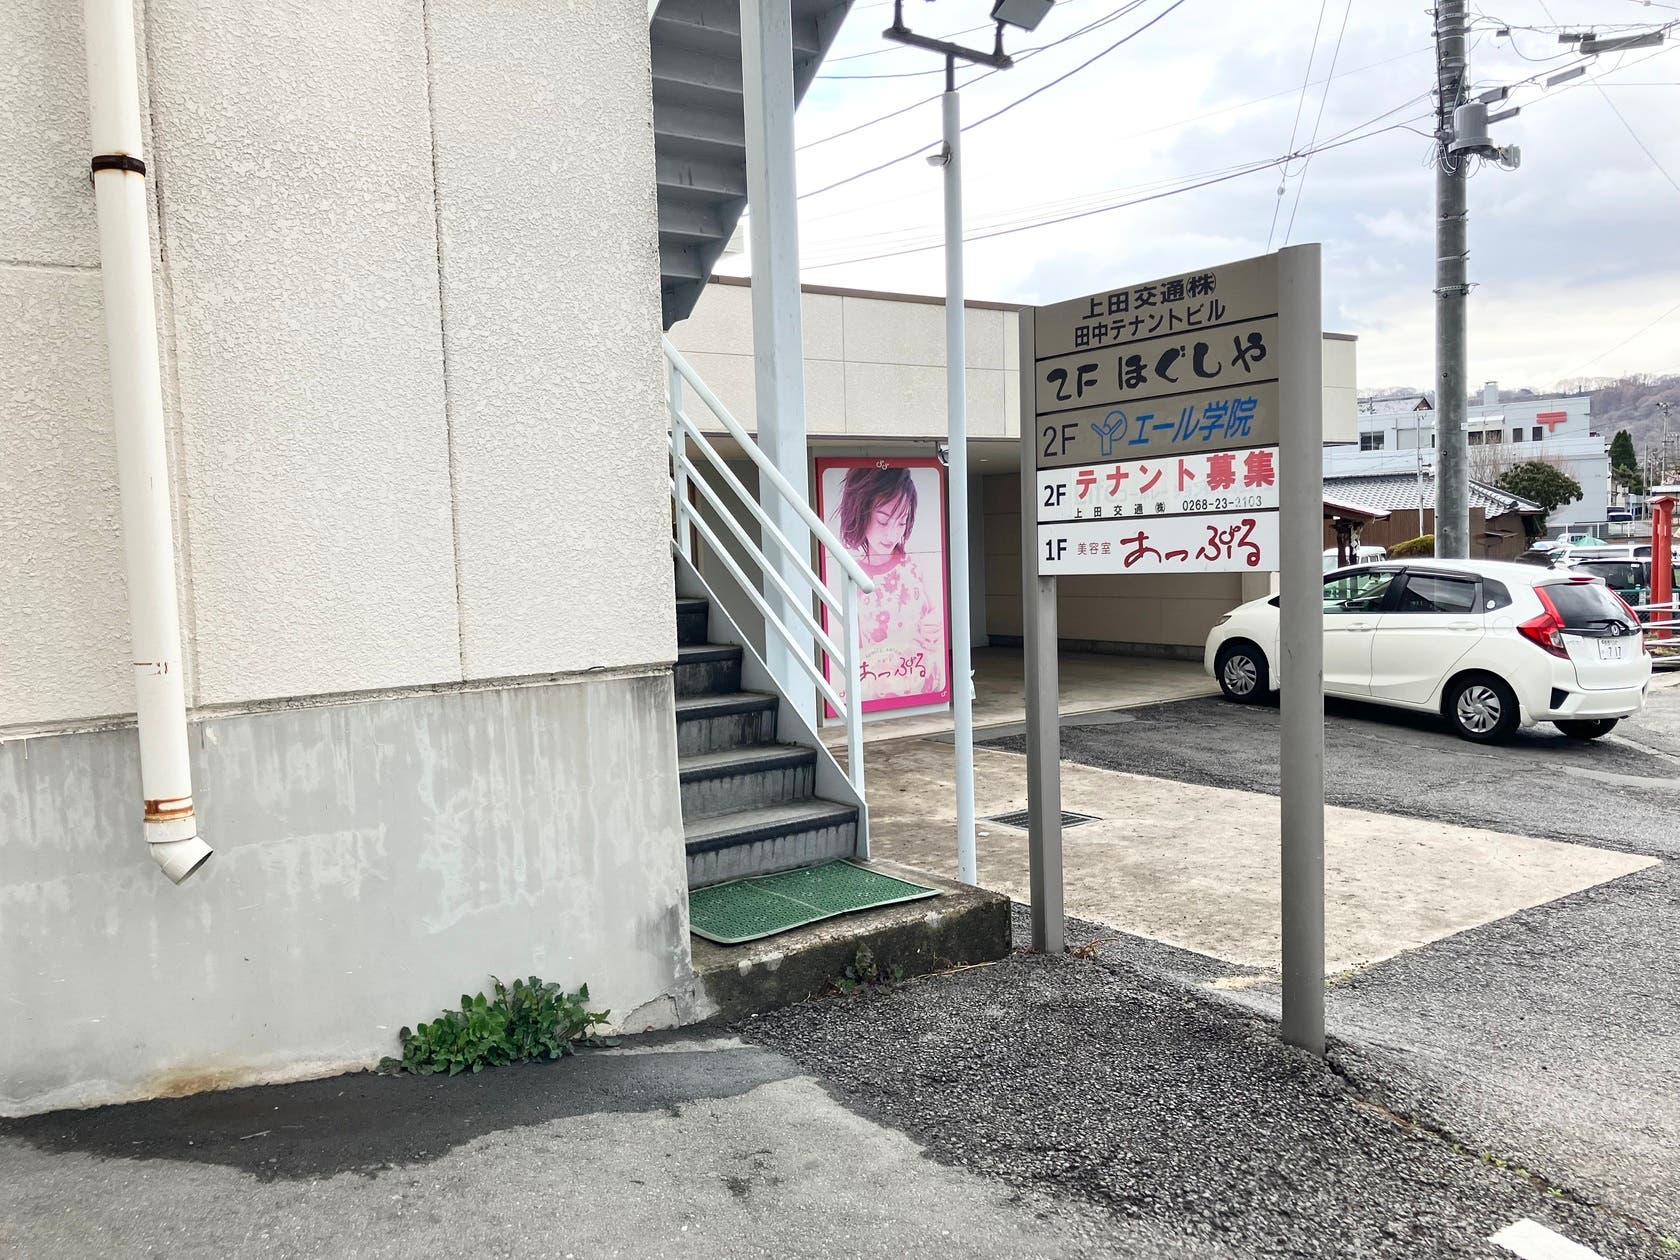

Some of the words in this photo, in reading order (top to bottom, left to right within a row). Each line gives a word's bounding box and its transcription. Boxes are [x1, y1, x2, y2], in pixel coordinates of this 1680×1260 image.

[1074, 298, 1226, 348] 田中テナントビル
[1046, 363, 1099, 401] 2F
[1117, 332, 1267, 391] ほぐしや
[1043, 422, 1079, 457] 2F
[1128, 396, 1259, 446] エール学院
[1044, 484, 1067, 507] 2F
[1075, 450, 1276, 500] テナント募集
[1182, 495, 1263, 512] 0268-23-2103
[1045, 538, 1068, 561] 1F
[1077, 542, 1112, 555] 美容室
[1119, 518, 1261, 568] あっぷる
